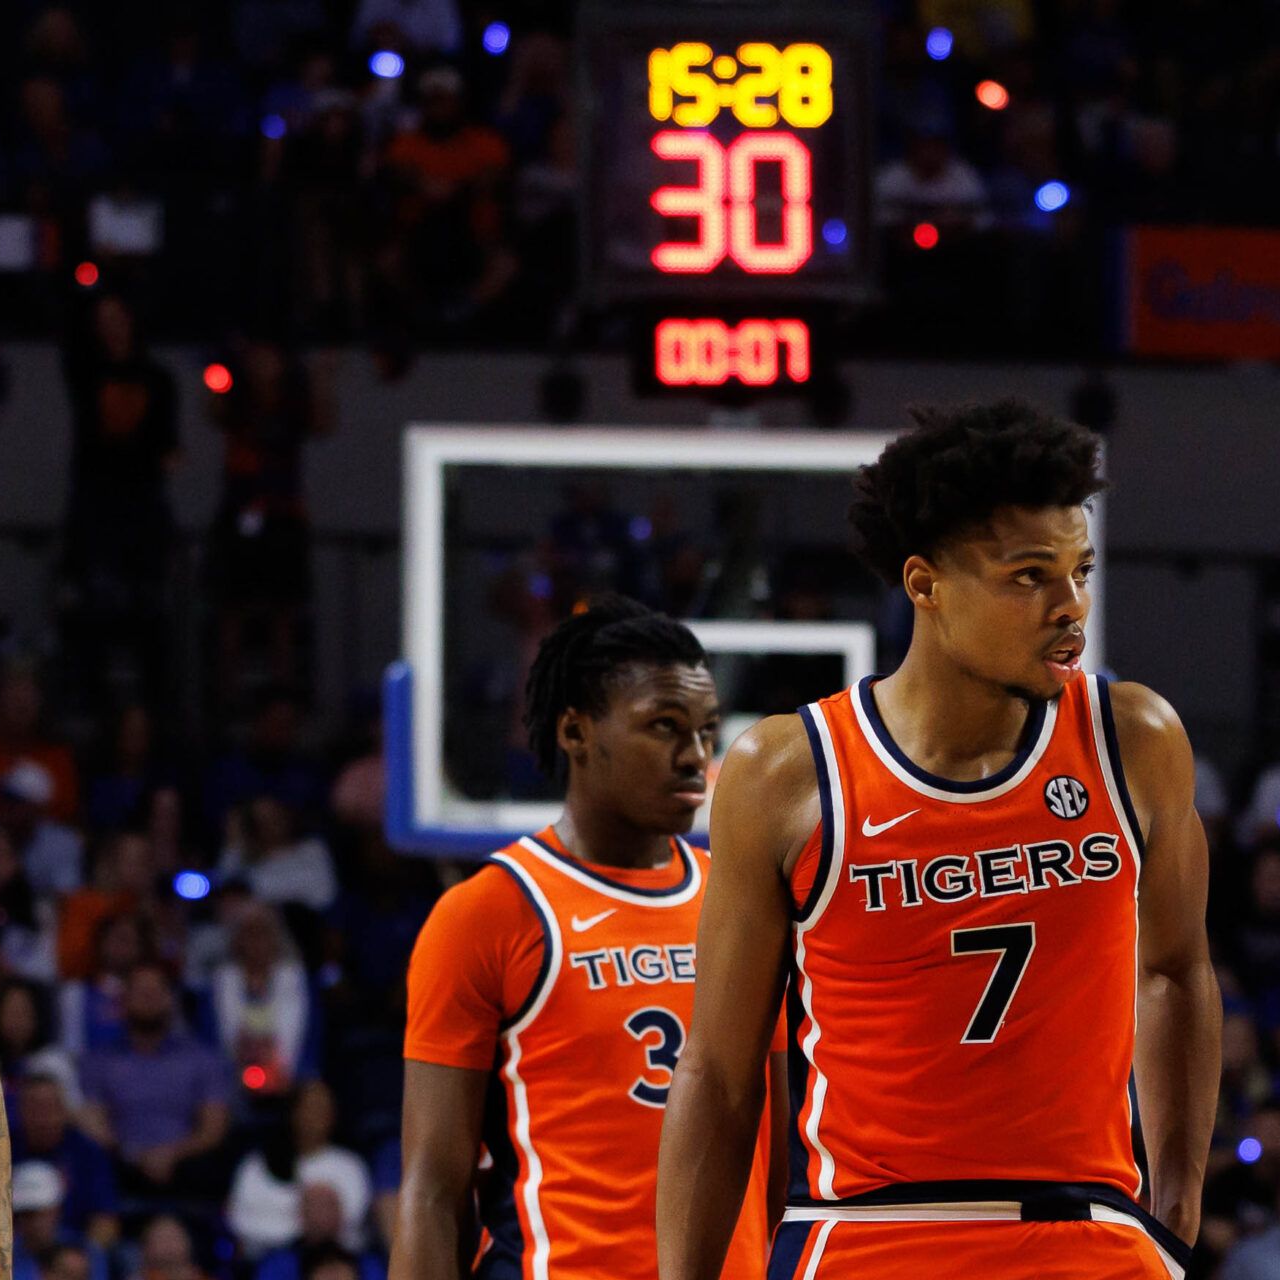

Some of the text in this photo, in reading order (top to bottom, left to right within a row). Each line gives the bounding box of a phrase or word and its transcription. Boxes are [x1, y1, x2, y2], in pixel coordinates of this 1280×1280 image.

[649, 42, 832, 127] 15:28
[651, 131, 812, 272] 30
[656, 318, 809, 385] 00:07
[1045, 776, 1088, 819] SEC
[849, 832, 1122, 911] TIGERS
[569, 943, 697, 990] TIGE
[951, 922, 1036, 1044] 7
